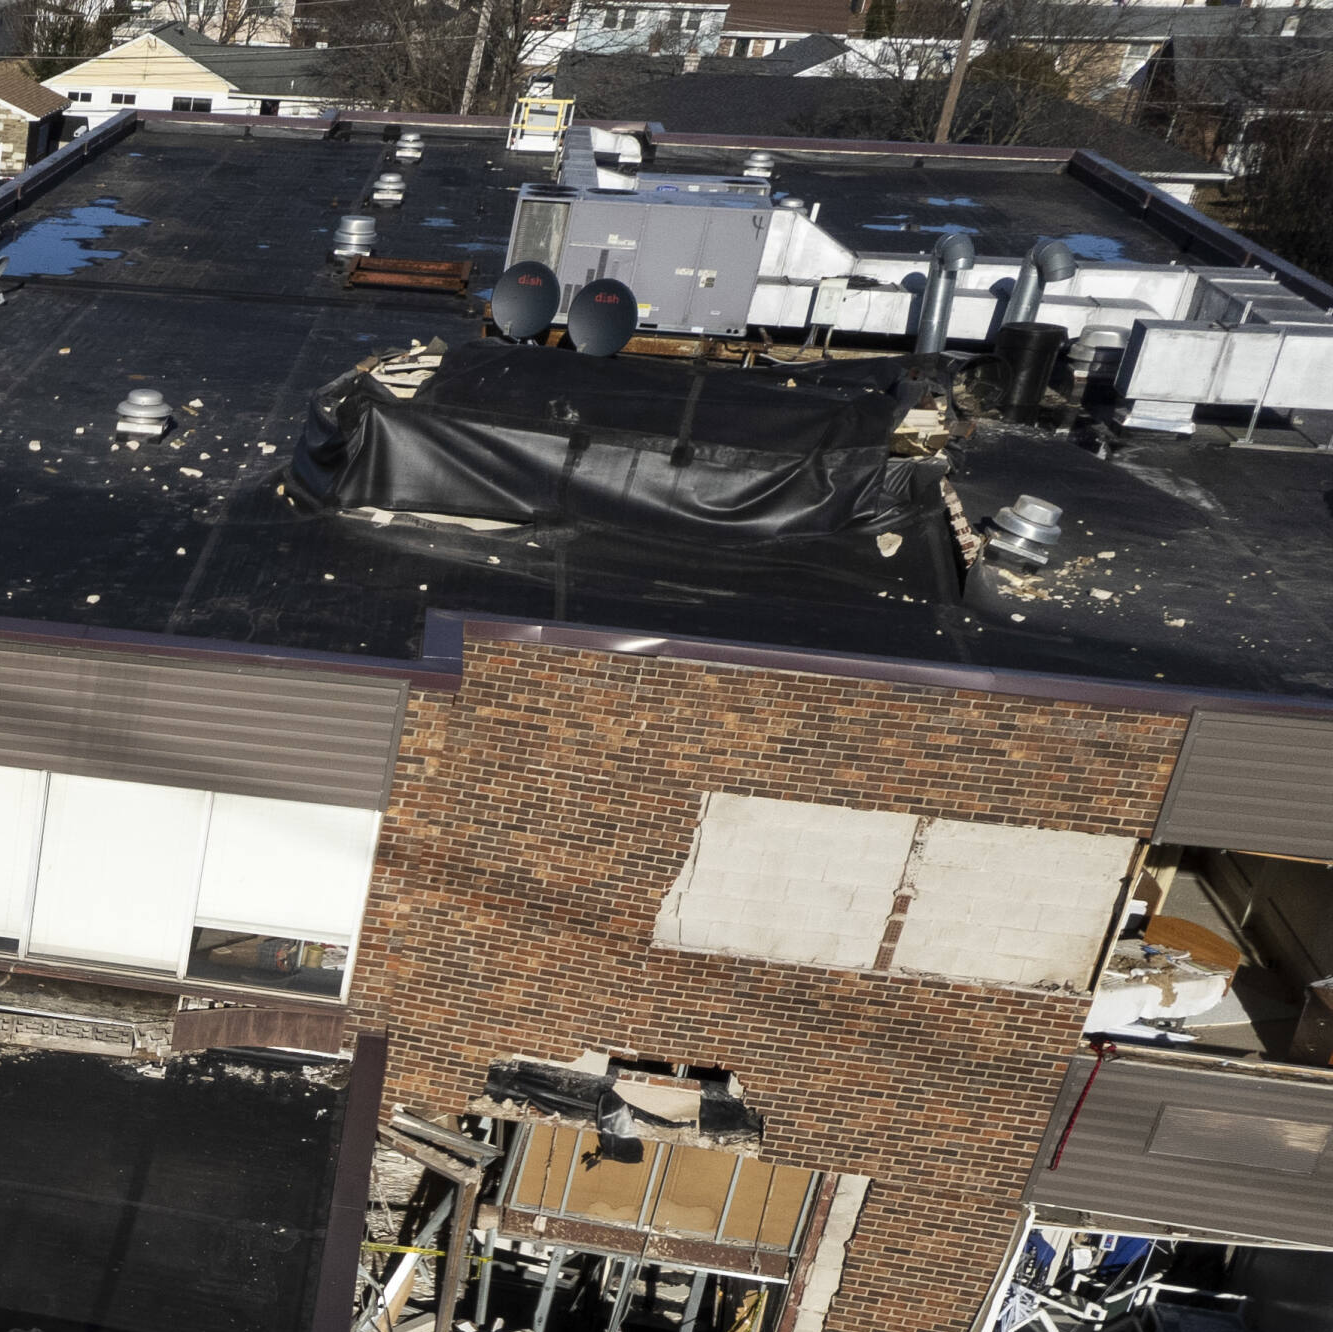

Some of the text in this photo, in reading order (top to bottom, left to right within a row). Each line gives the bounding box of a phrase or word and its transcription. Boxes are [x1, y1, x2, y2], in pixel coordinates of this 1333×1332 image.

[752, 214, 765, 241] 4
[518, 274, 542, 287] dish
[595, 292, 619, 304] dish
